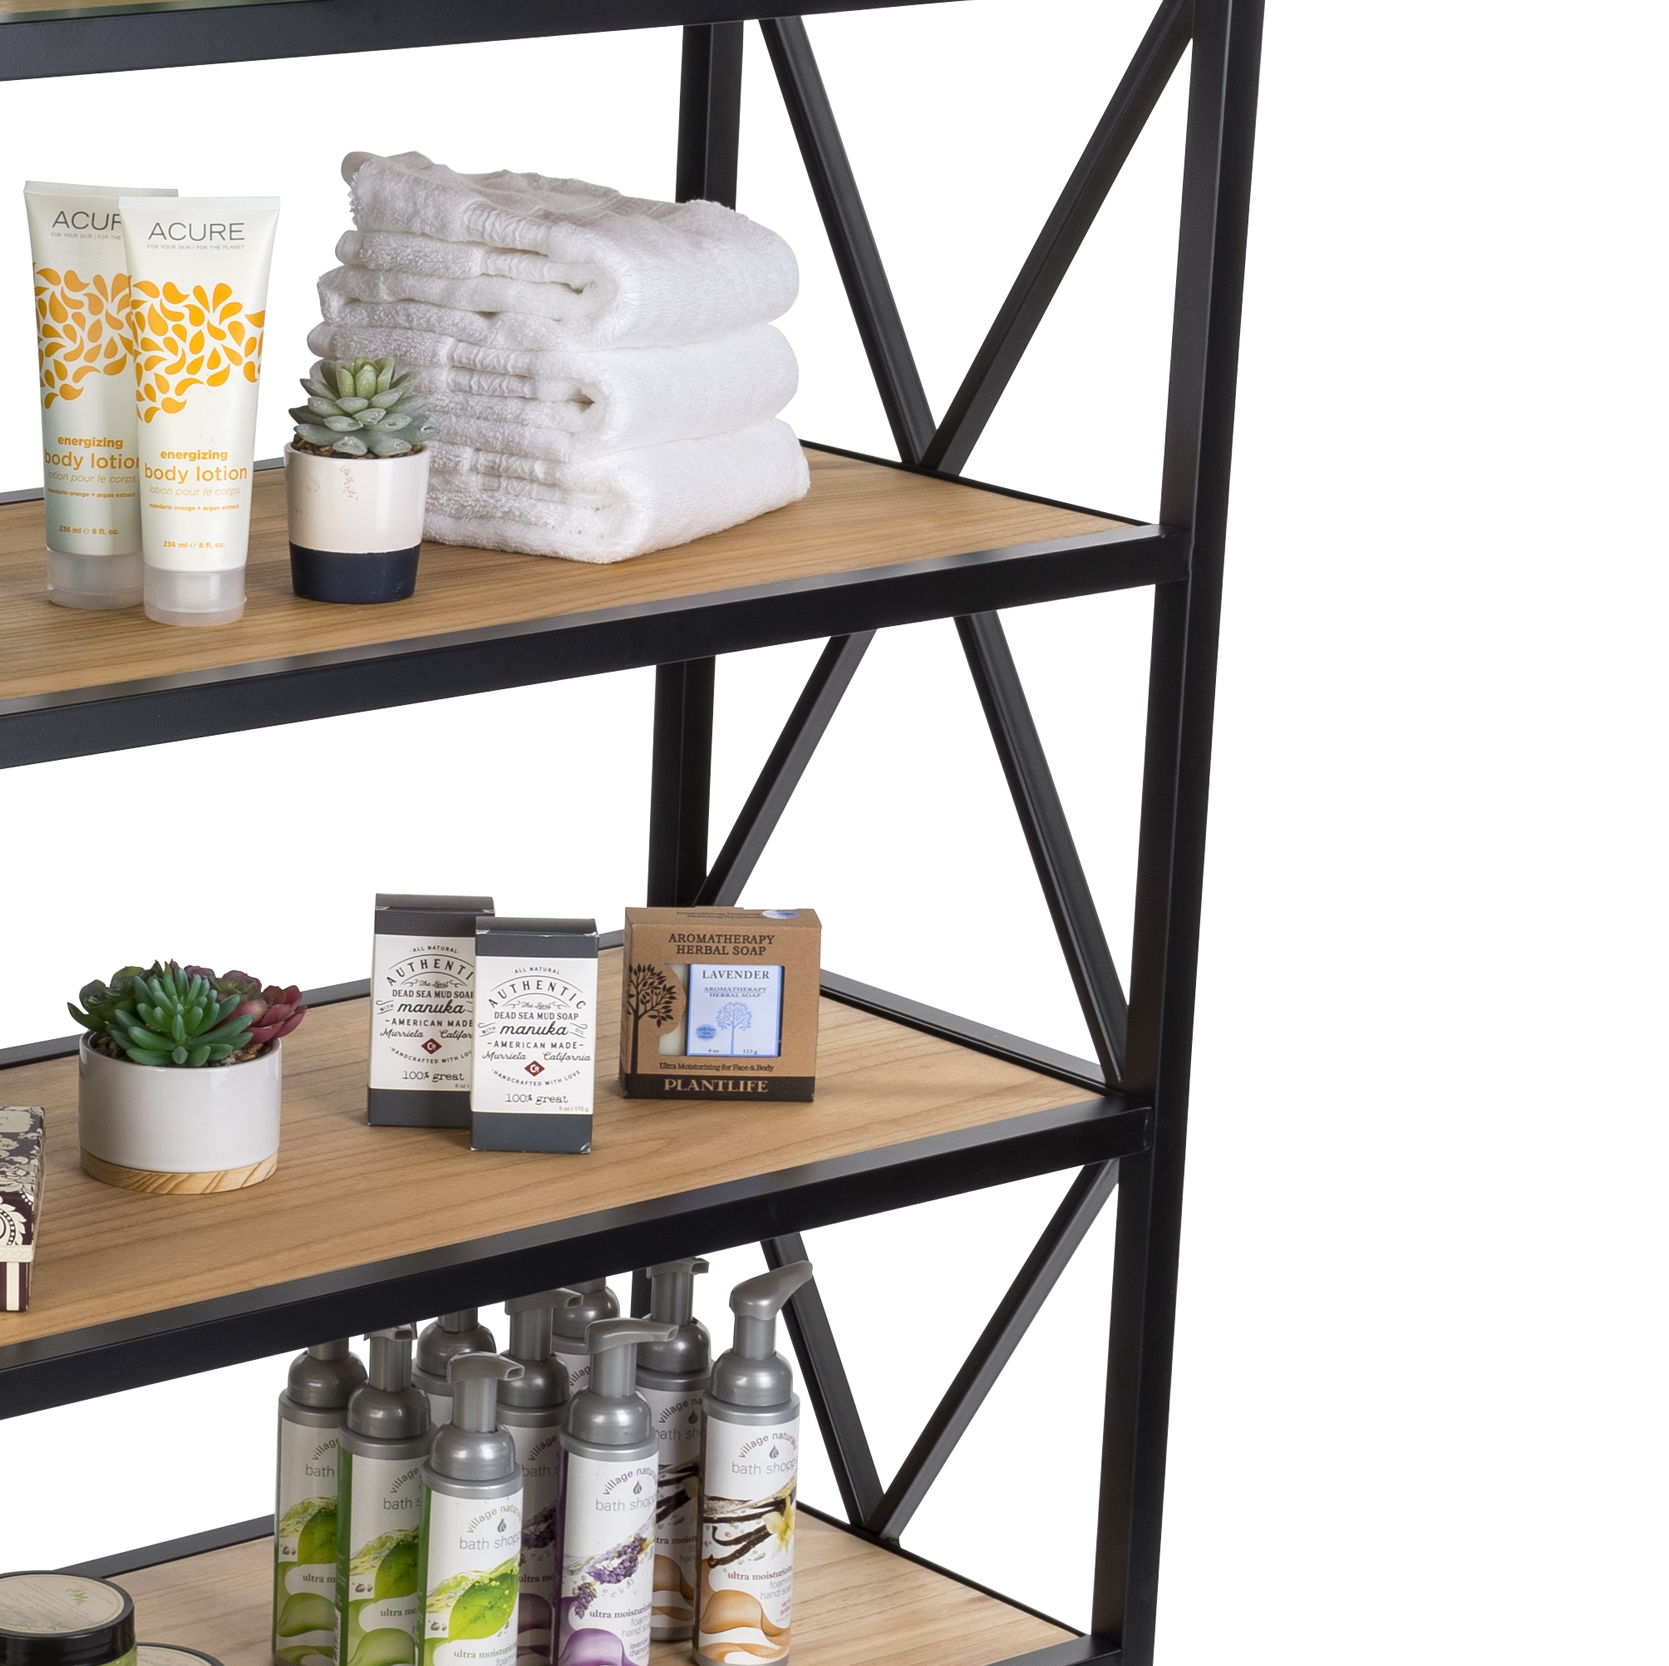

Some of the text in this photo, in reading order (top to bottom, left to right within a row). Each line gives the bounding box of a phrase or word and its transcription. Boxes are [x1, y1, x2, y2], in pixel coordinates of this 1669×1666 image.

[148, 222, 245, 242] ACURE
[57, 436, 124, 449] energizing
[45, 448, 83, 470] body
[160, 450, 228, 462] energizing
[47, 470, 136, 484] lotion pour le corps
[145, 463, 247, 484] body lotion
[148, 485, 240, 497] lotion pour le corps
[59, 525, 71, 533] 236
[668, 933, 775, 945] AROMATHERAPY
[428, 945, 458, 954] NATURAL
[676, 945, 767, 956] HERBAL SOAP
[529, 966, 560, 975] NATURAL
[702, 970, 770, 980] LAVENDER
[392, 989, 452, 998] DEAD SEA MUD
[488, 980, 586, 1009] AUTHENTIC
[397, 999, 466, 1014] manuka
[494, 1011, 579, 1020] DEAD SEA MUD SOAP
[391, 1018, 473, 1027] AMERICAN MADE
[499, 1021, 568, 1036] manuka
[380, 1028, 424, 1038] Murrieta
[494, 1040, 546, 1049] AMERICAN
[391, 1047, 458, 1064] HANDCRAFTED WITH
[482, 1051, 591, 1063] Murrieta California
[677, 1063, 721, 1072] Moisturizing
[756, 1065, 774, 1073] Body
[402, 1070, 465, 1082] 100% great
[493, 1069, 581, 1086] HANDCRAFTED WITH LOVE
[664, 1078, 769, 1092] PLANTLIFE
[504, 1093, 568, 1105] 100% great
[658, 1400, 688, 1424] village
[528, 1435, 557, 1462] village
[738, 1433, 769, 1458] village
[305, 1464, 335, 1477] bath
[521, 1464, 550, 1477] bath
[732, 1461, 762, 1475] bath
[390, 1467, 419, 1494] village
[603, 1469, 634, 1496] village
[383, 1498, 412, 1510] bath
[595, 1499, 625, 1511] bath
[466, 1507, 497, 1534] village
[459, 1537, 489, 1550] bath
[302, 1573, 324, 1583] ultra
[727, 1571, 750, 1580] ultra
[760, 1589, 779, 1600] hand
[380, 1608, 403, 1617] ultra
[589, 1610, 612, 1618] ultra
[621, 1625, 641, 1637] hand
[453, 1649, 476, 1659] ultra
